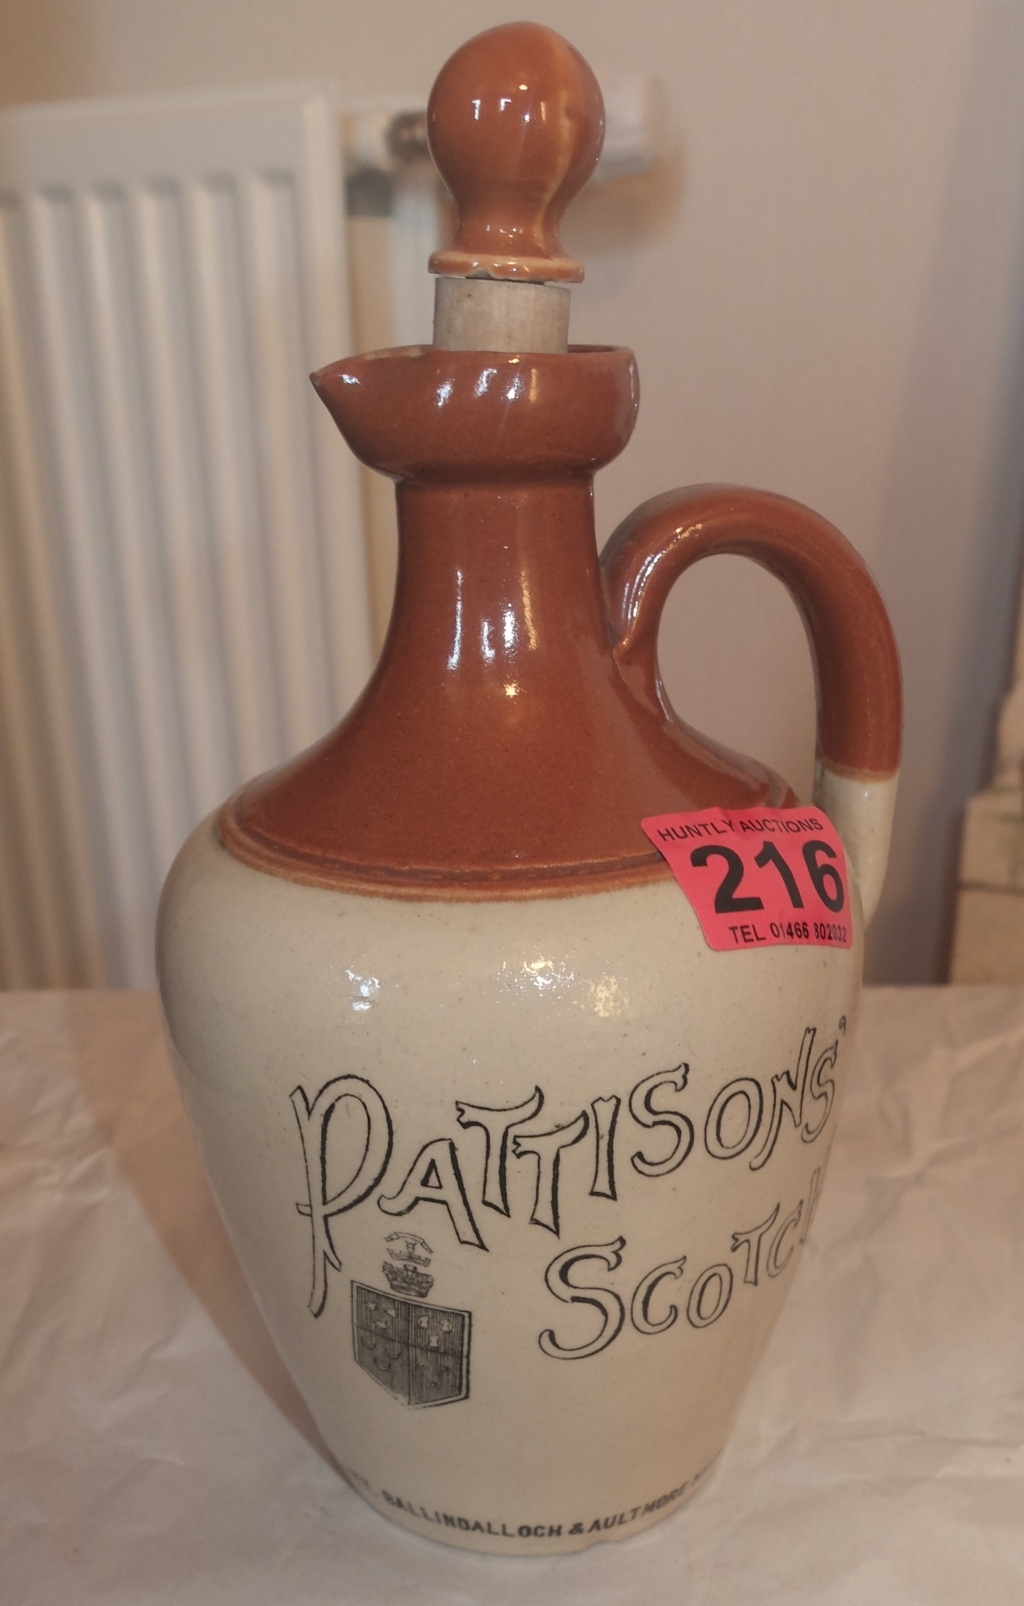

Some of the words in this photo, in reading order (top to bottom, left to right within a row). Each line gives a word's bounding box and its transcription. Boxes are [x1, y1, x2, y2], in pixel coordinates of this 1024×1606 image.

[657, 819, 736, 842] HUNTLY
[739, 818, 824, 834] AUCTIONS
[690, 839, 845, 914] 216
[728, 923, 767, 944] TEL
[769, 921, 809, 939] 01466
[813, 923, 847, 943] 802032
[381, 1489, 562, 1538] BALLINDALLOCH
[567, 1521, 585, 1536] &
[587, 1480, 690, 1534] AULTMORE
